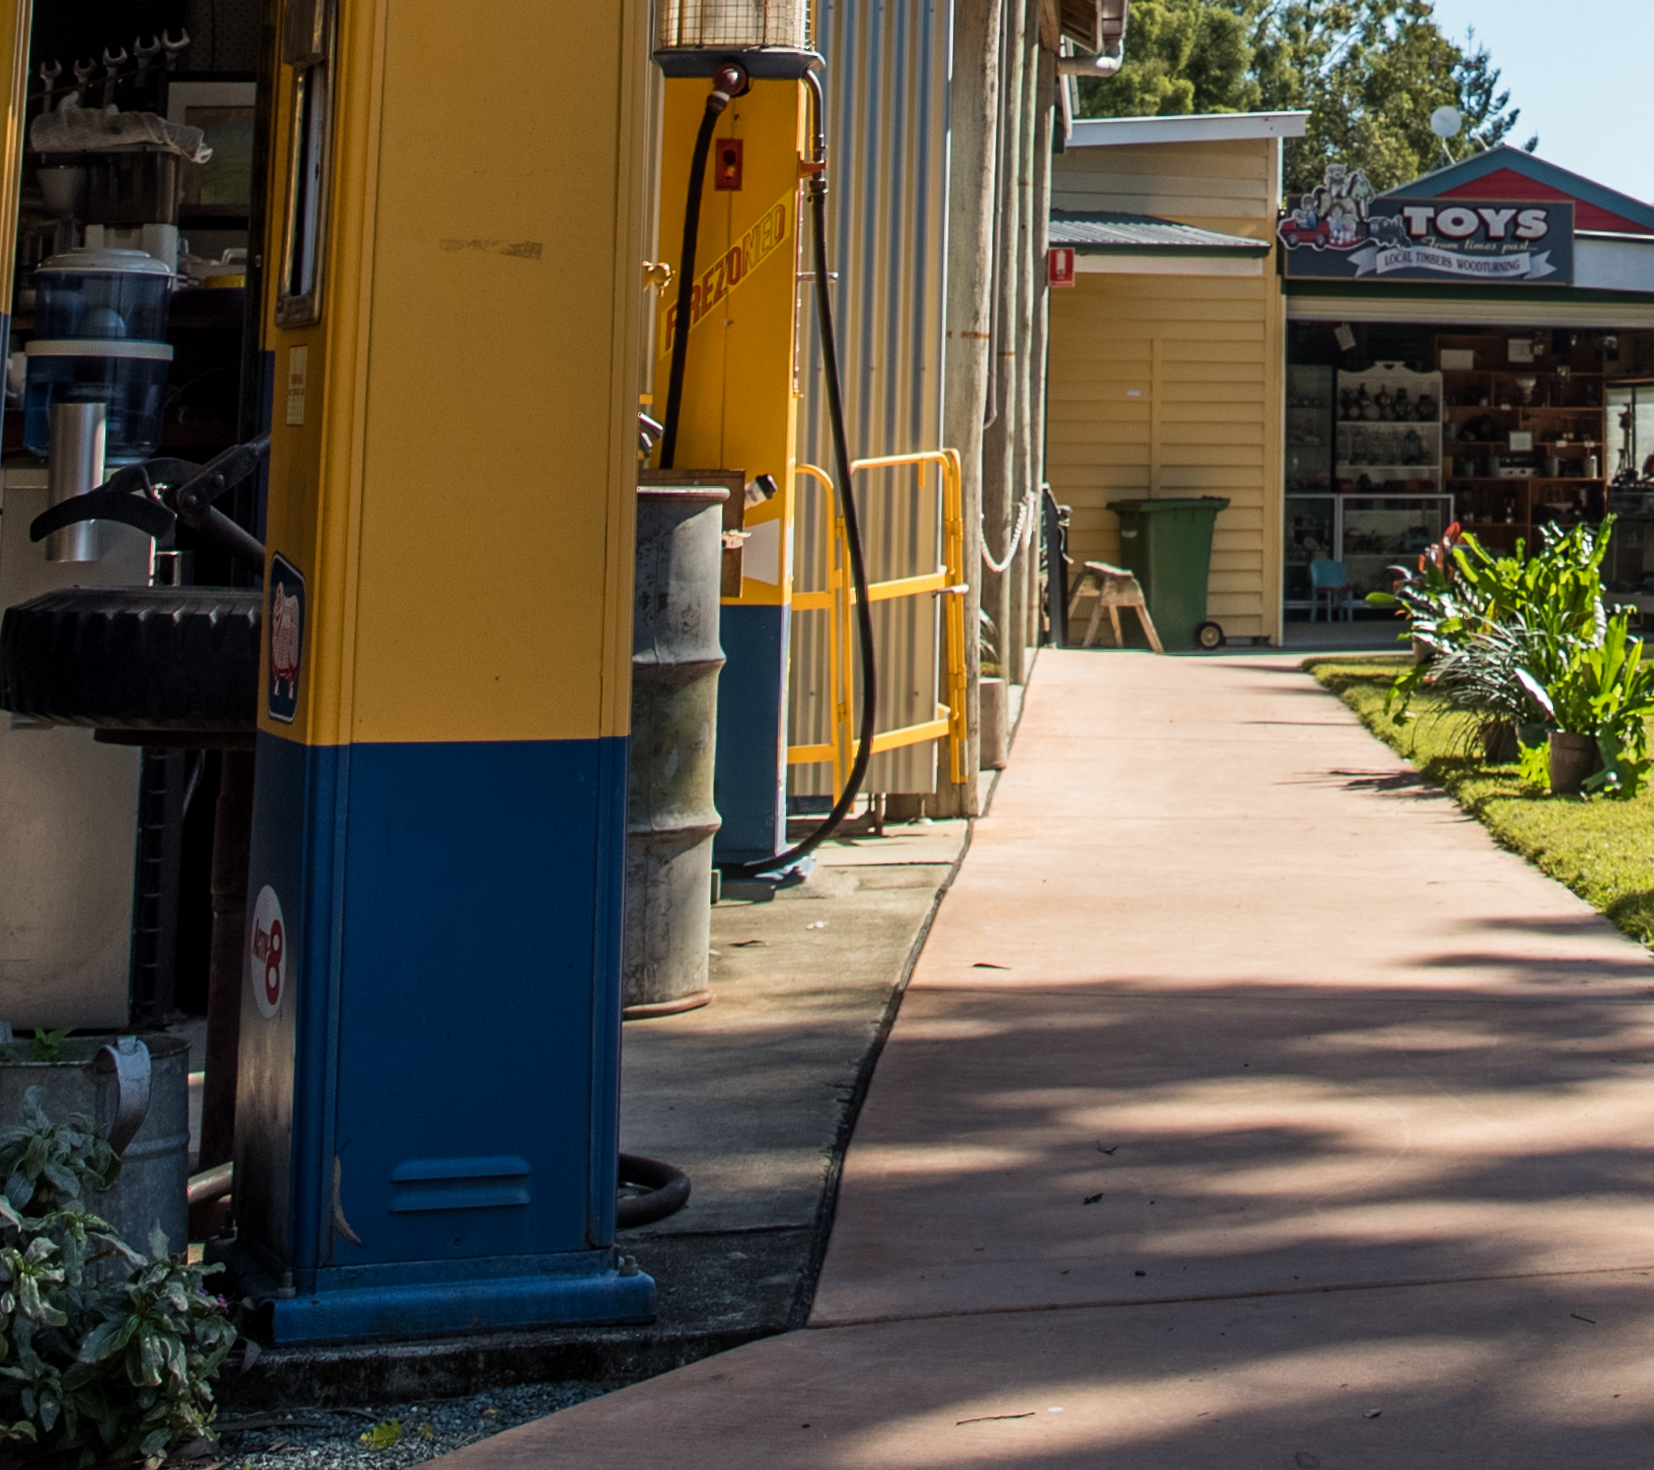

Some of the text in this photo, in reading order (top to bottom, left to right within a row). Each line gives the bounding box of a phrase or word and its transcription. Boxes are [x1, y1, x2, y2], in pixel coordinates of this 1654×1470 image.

[1402, 205, 1549, 240] TOYS
[1420, 235, 1459, 250] From
[1464, 238, 1497, 251] times
[1384, 251, 1520, 273] LOCAL TIMBERS WOODTURNING
